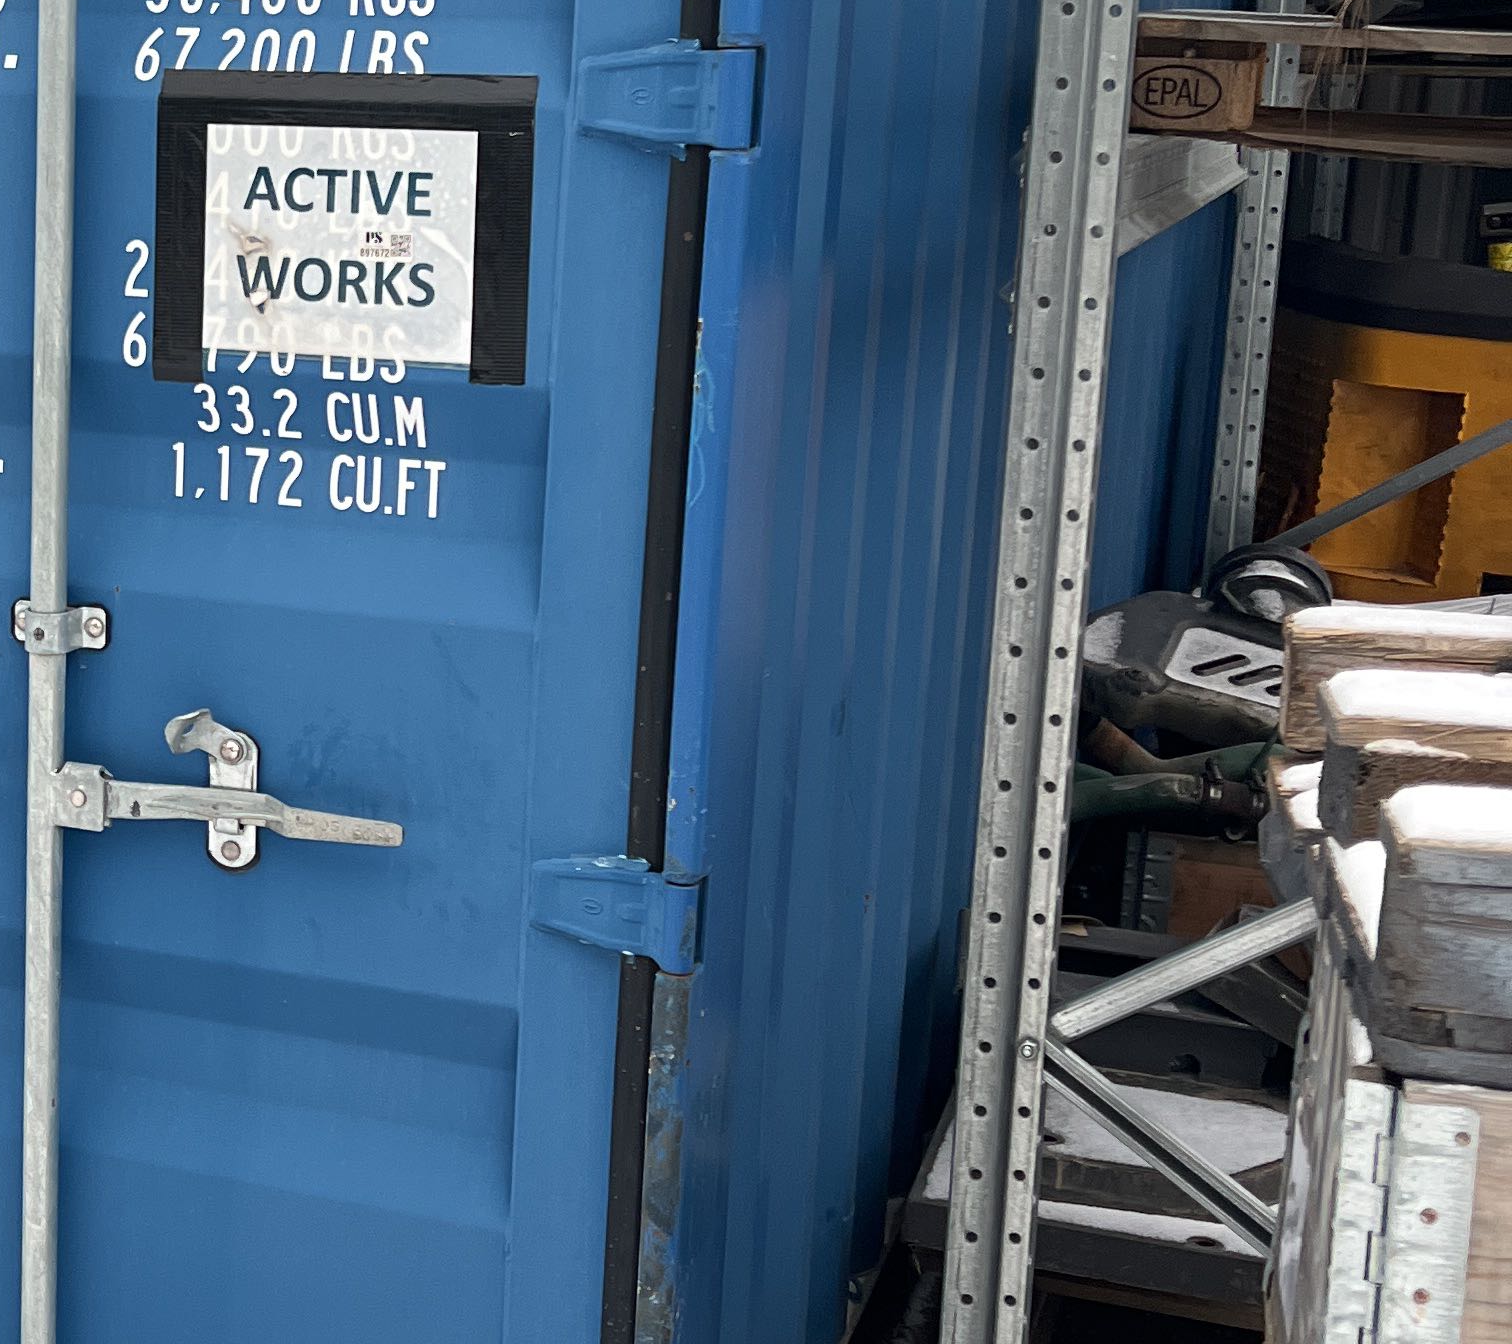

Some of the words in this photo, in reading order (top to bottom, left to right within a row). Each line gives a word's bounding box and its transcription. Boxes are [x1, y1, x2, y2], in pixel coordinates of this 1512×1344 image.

[1143, 76, 1208, 110] EPAL
[243, 166, 434, 217] ACTIVE
[236, 254, 436, 308] WORKS
[193, 383, 304, 440] 33.2
[326, 391, 427, 448] CU.M
[172, 441, 305, 508] 1,172
[329, 454, 447, 519] CU.FT
